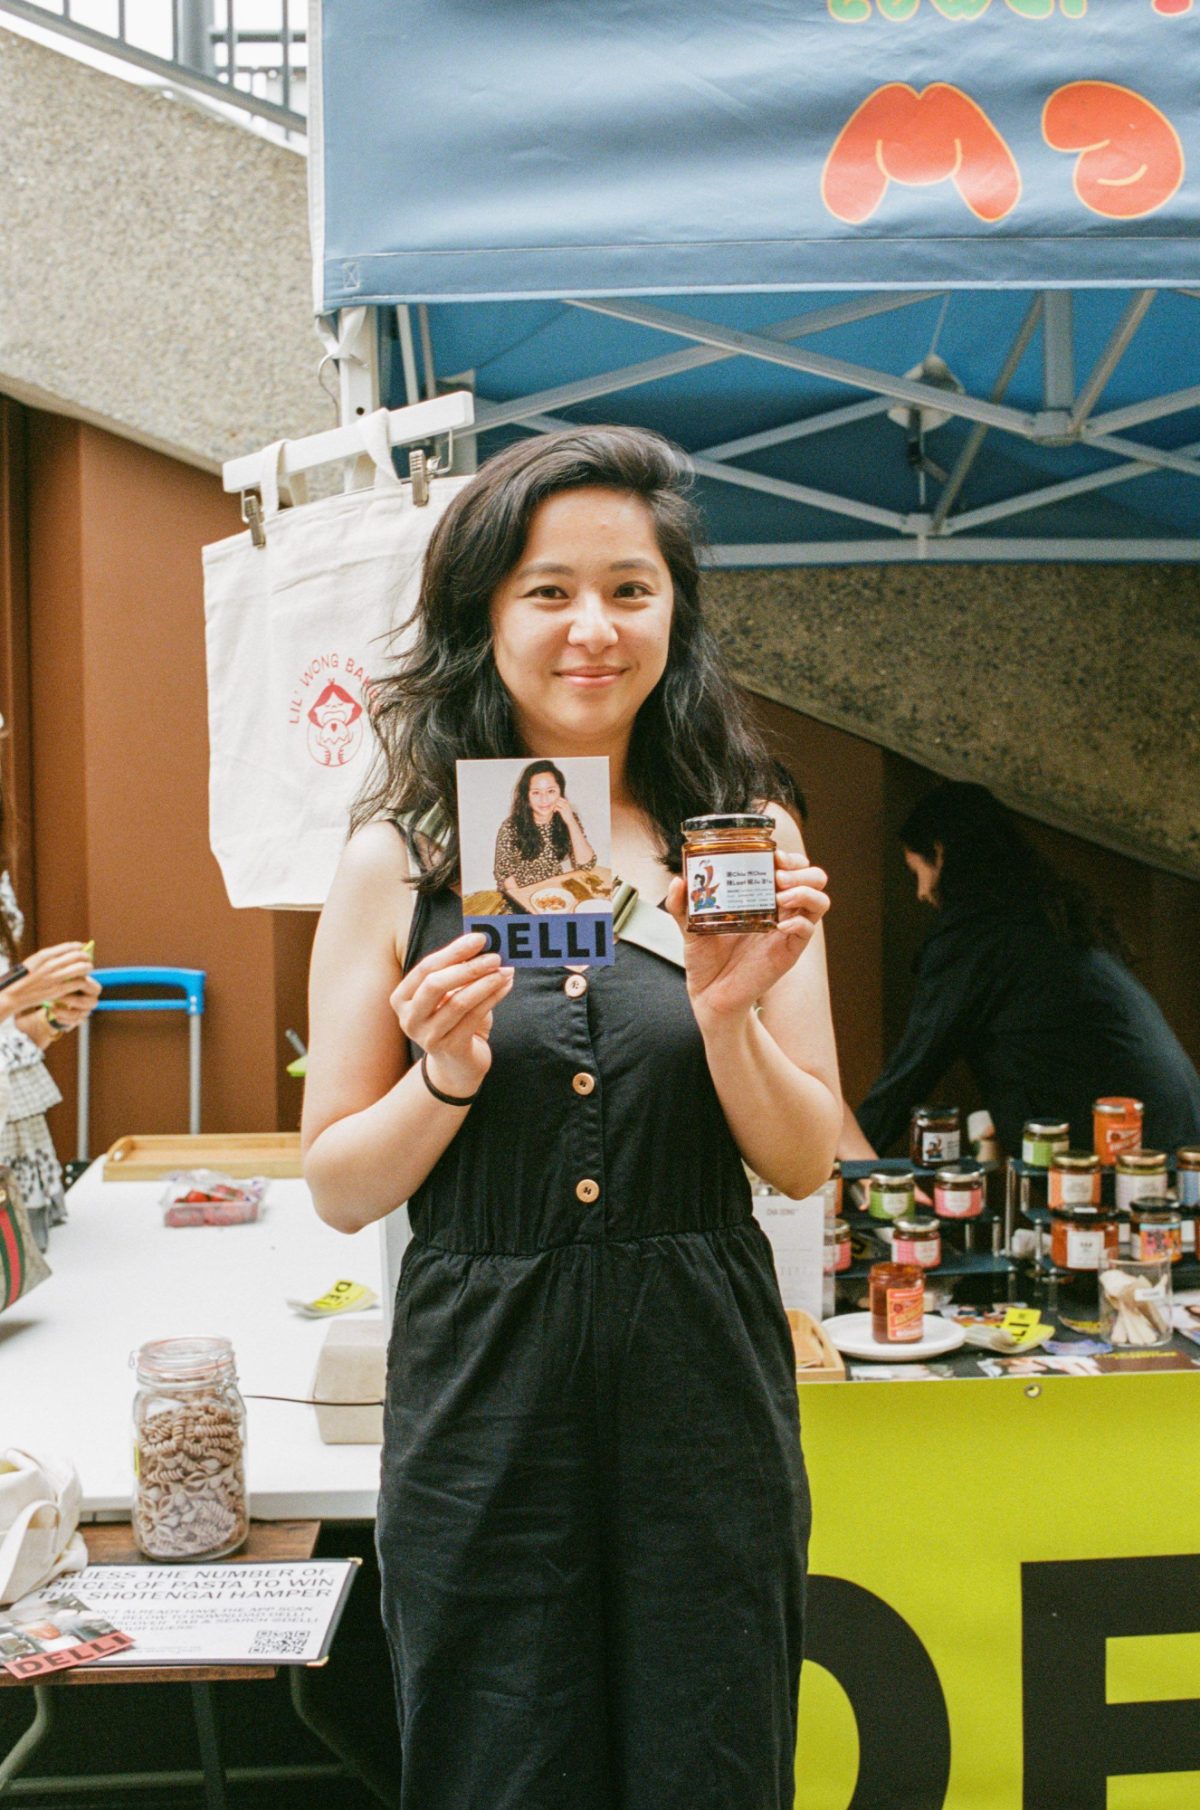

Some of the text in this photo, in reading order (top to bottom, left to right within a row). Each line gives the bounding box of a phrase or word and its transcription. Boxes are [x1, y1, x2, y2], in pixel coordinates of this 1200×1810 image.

[300, 653, 339, 687] WONG
[471, 920, 606, 959] DELLI
[134, 1580, 164, 1590] OF
[171, 1579, 243, 1590] PASTA
[254, 1579, 281, 1589] TO
[288, 1578, 335, 1588] WIN
[147, 1570, 182, 1579] THE
[194, 1568, 294, 1579] NUMBER
[302, 1567, 332, 1577] OF
[87, 1590, 223, 1600] SHOTENGAI
[230, 1588, 332, 1599] HAMPER
[15, 1635, 128, 1674] DELLI
